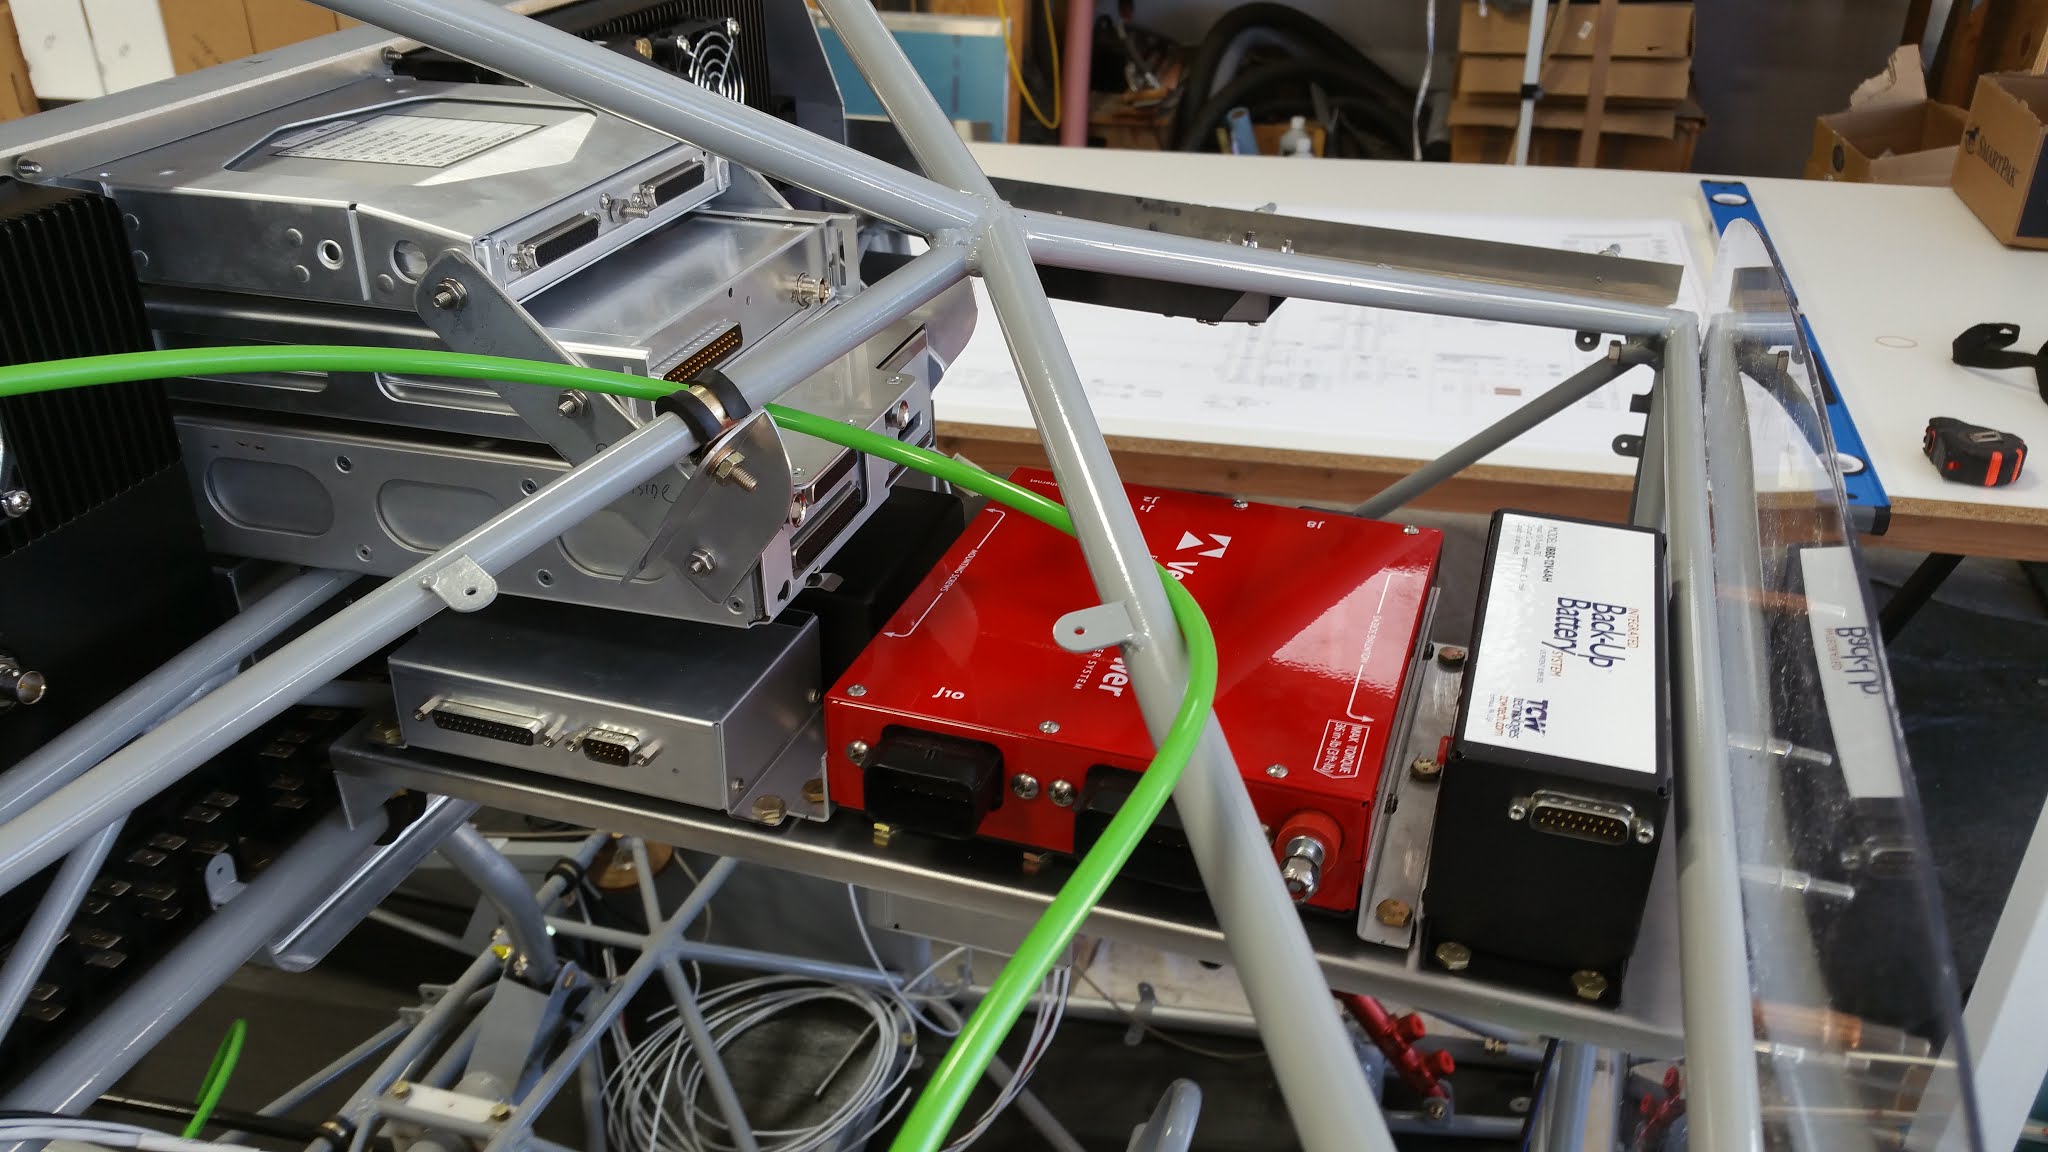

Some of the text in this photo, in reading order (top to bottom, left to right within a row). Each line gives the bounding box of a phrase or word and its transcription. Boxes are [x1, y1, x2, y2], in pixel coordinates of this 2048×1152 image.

[1030, 478, 1058, 487] thernet
[1143, 496, 1160, 504] J2
[1140, 504, 1156, 512] J1
[1306, 520, 1325, 530] J8
[940, 549, 978, 592] MOUNTING SCREWS
[1542, 597, 1592, 678] Battery SYSTEM
[1578, 602, 1627, 669] Back-Up
[1627, 608, 1640, 648] INTEGRATED
[932, 685, 965, 700] J10
[1073, 659, 1098, 690] SYSTEM
[1098, 656, 1128, 697] wer
[1505, 697, 1524, 739] technologies
[1524, 699, 1549, 734] TCW
[1339, 724, 1362, 774] MAX TORQUE
